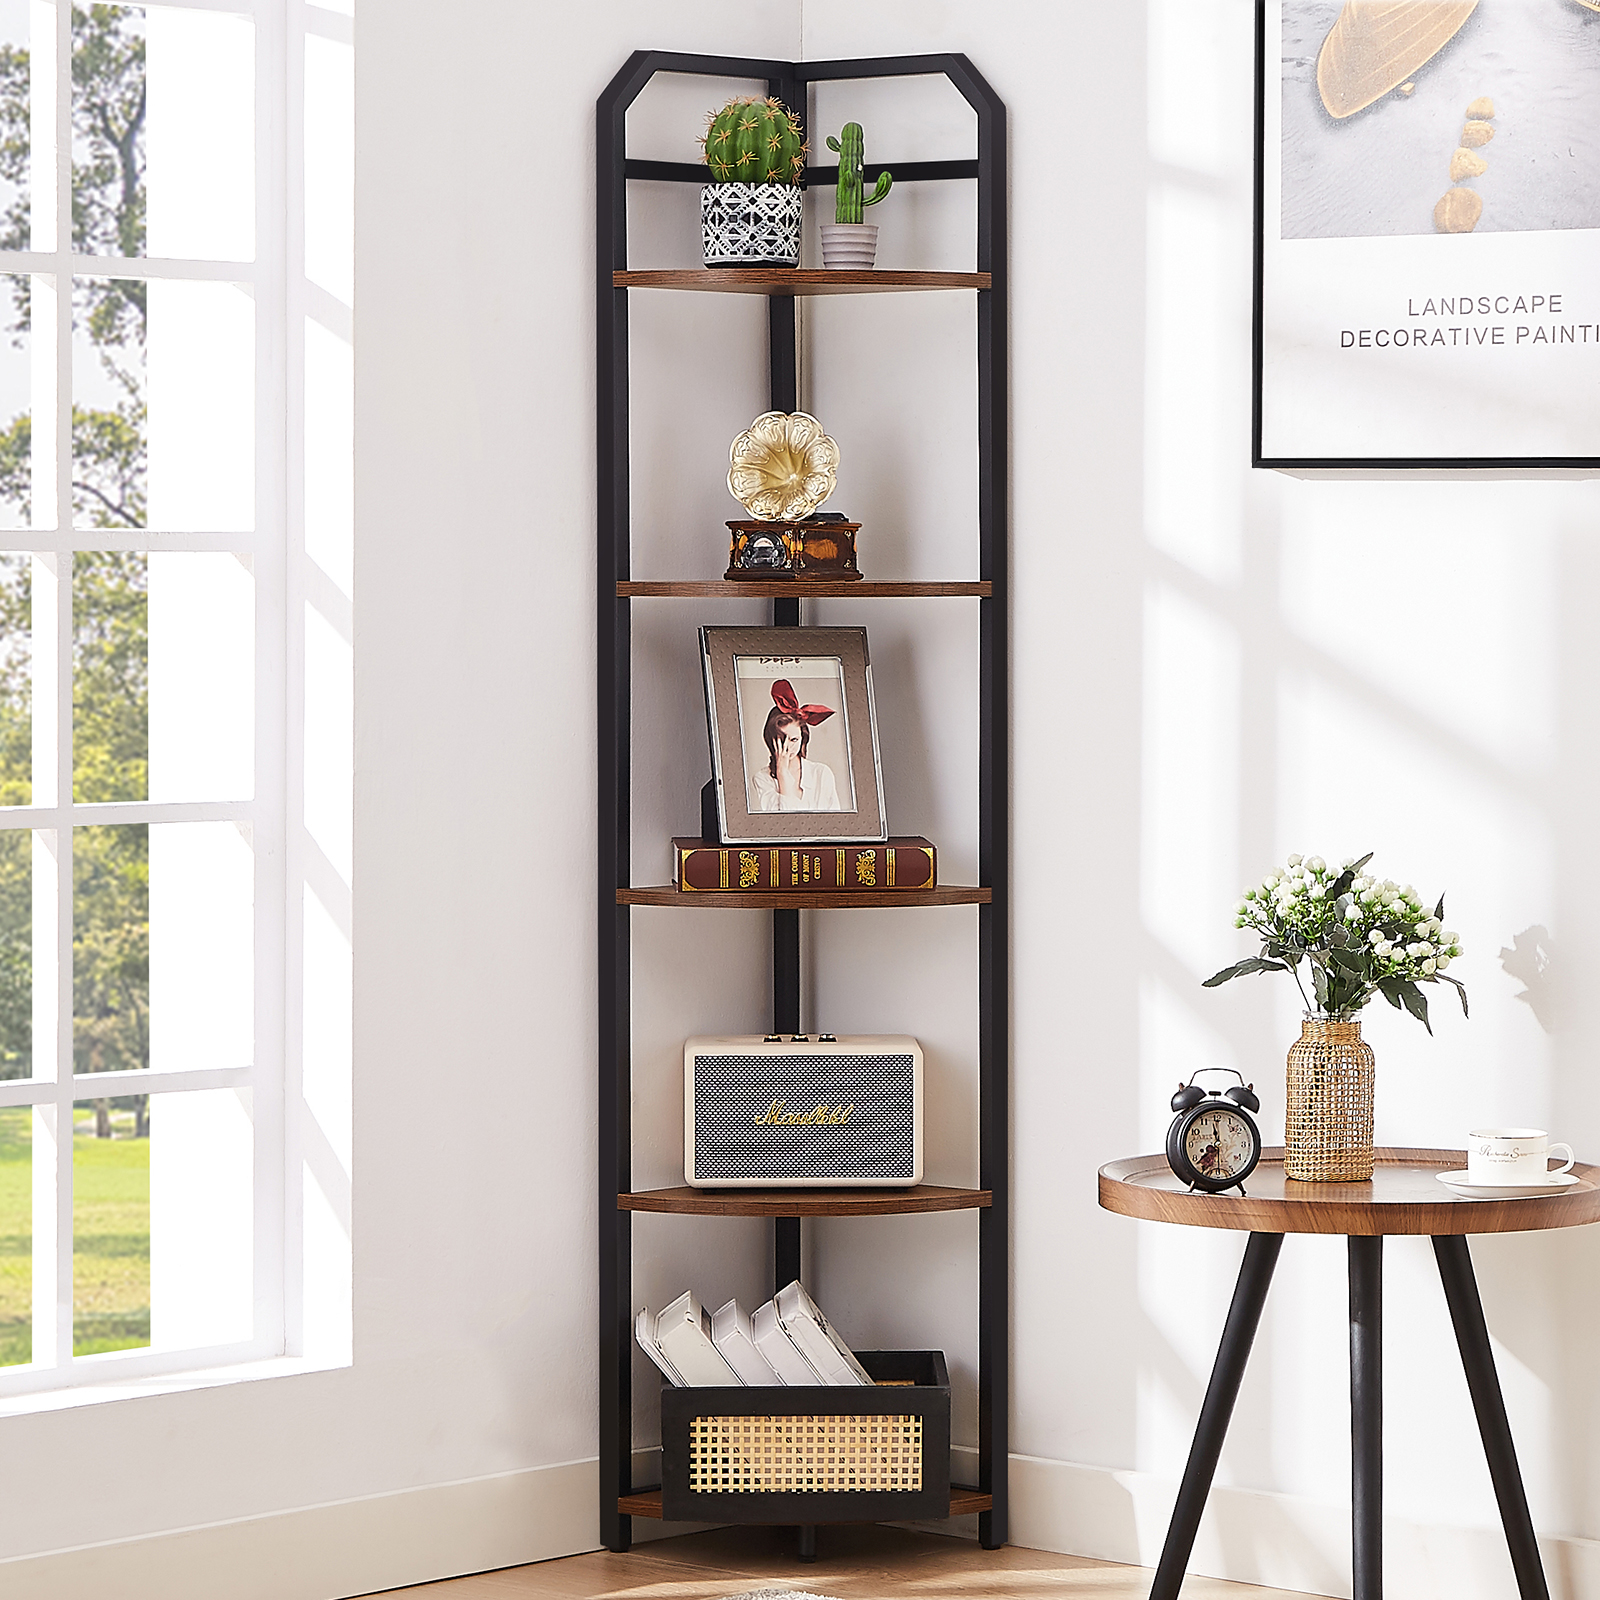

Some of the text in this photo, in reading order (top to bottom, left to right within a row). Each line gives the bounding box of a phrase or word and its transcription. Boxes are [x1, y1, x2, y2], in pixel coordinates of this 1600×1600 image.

[1408, 294, 1563, 316] LANDSCAPE
[1340, 324, 1600, 348] DECORATIVE PAINTI
[1213, 1114, 1222, 1122] 12
[1191, 1128, 1200, 1136] 10
